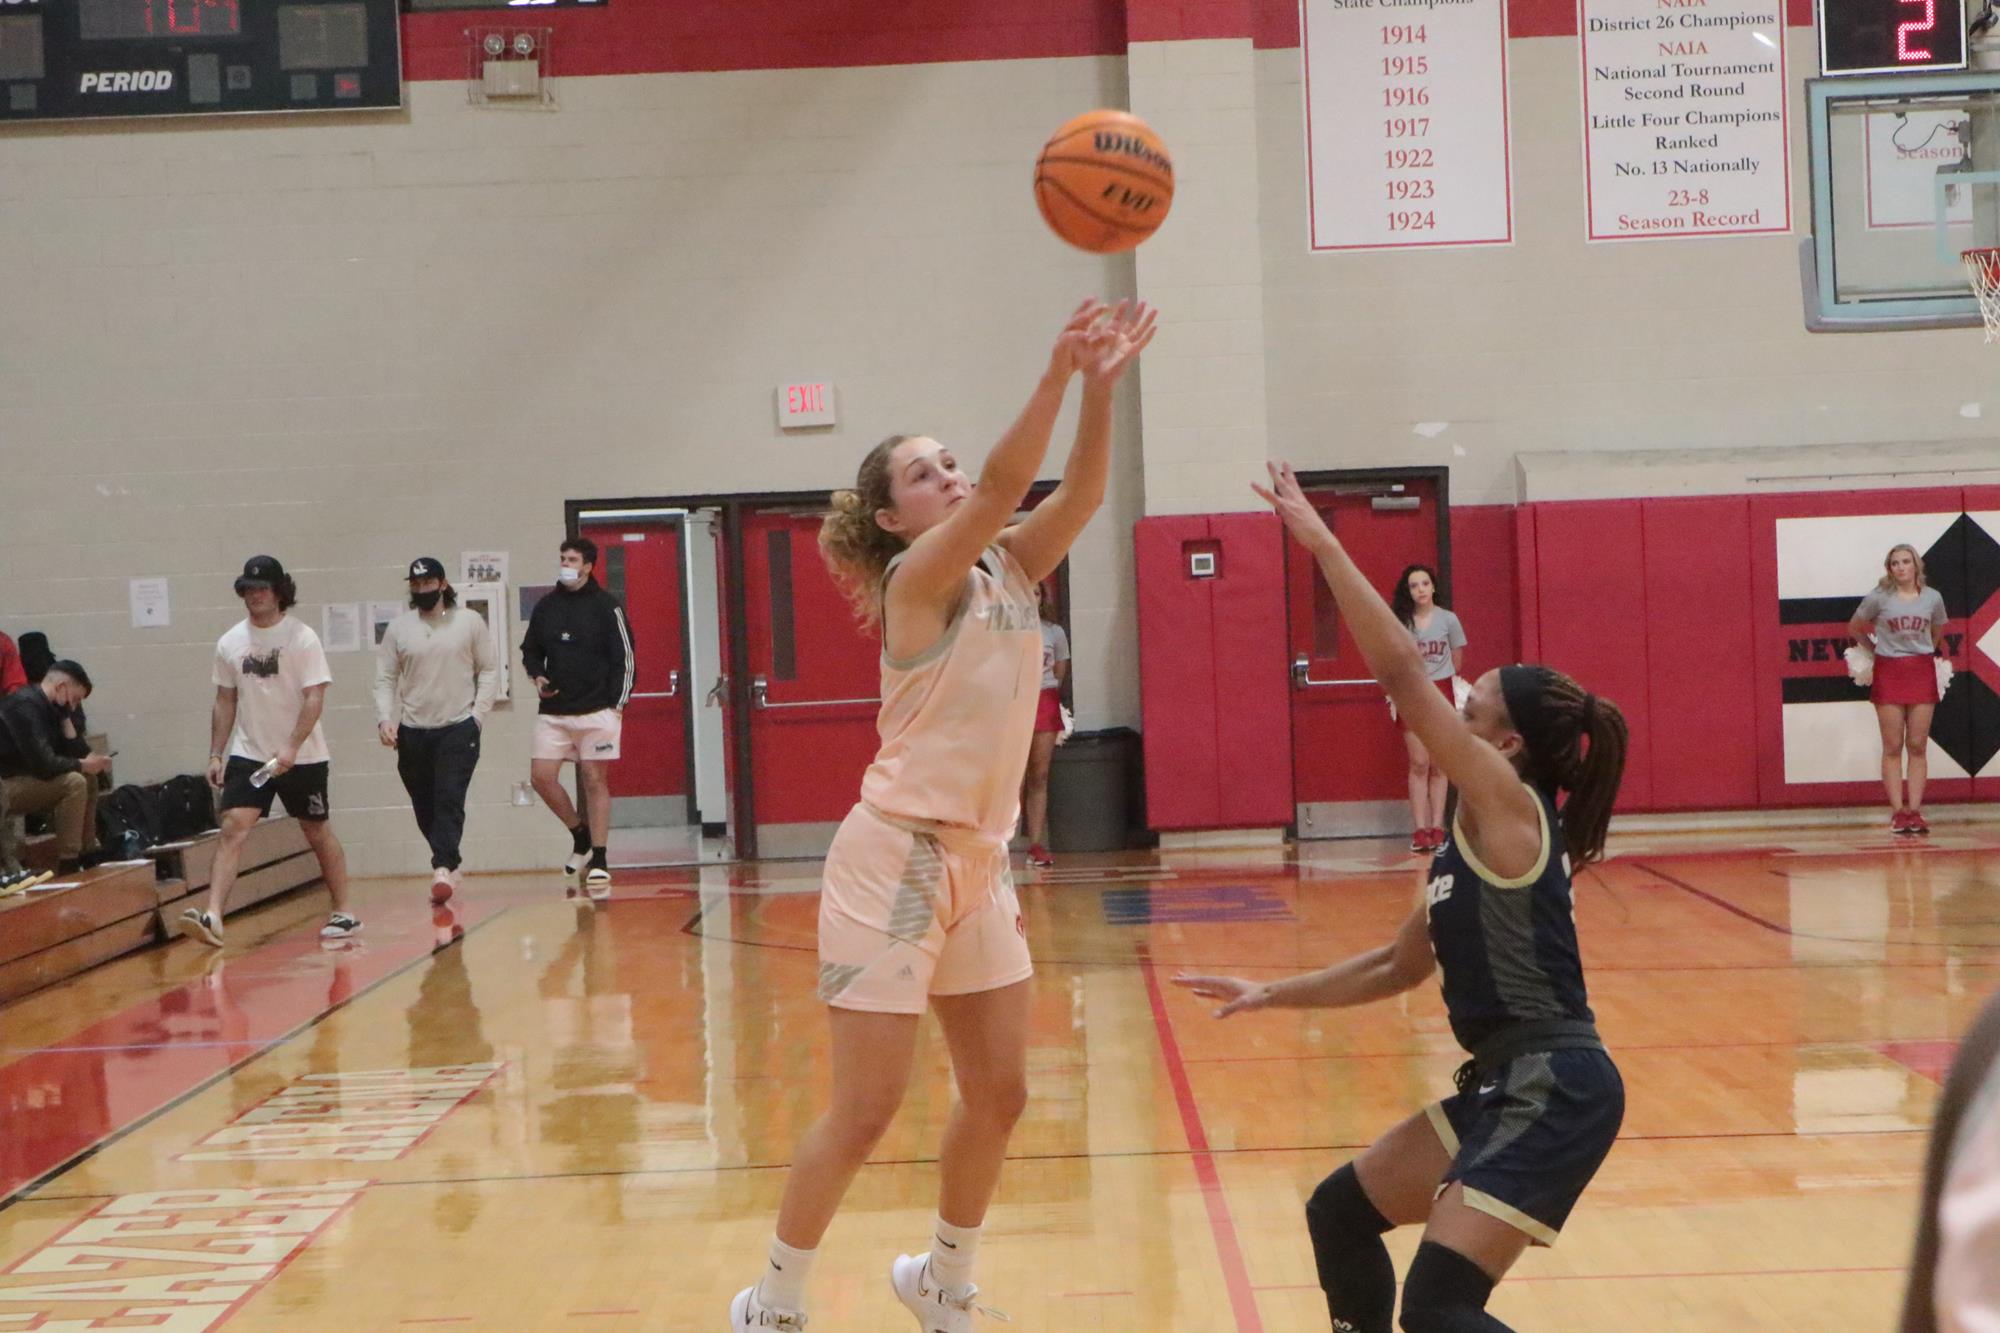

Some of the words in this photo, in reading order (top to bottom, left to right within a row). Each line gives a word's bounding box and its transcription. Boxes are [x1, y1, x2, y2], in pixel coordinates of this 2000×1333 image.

[1589, 17, 1651, 33] District
[1656, 15, 1674, 29] 26
[1680, 12, 1775, 31] Champions
[1898, 0, 1934, 61] 2
[1381, 24, 1427, 45] 1914
[1658, 41, 1709, 56] NAIA
[1382, 56, 1428, 76] 1915
[1594, 65, 1666, 81] National
[1672, 61, 1775, 77] Tournament
[80, 70, 173, 93] PERIOD
[1624, 85, 1684, 101] Second
[1690, 82, 1745, 97] Round
[1382, 87, 1430, 107] 1916
[1384, 118, 1430, 138] 1917
[1592, 113, 1636, 129] Little
[1642, 113, 1680, 127] Four
[1685, 108, 1781, 128] Champions
[1655, 134, 1718, 150] Ranked
[1896, 144, 1963, 160] Season
[1385, 149, 1434, 169] 1922
[1615, 162, 1646, 177] No.
[1652, 161, 1668, 176] 13
[1673, 157, 1760, 175] Nationally
[1386, 180, 1435, 200] 1923
[1668, 189, 1710, 206] 23-8
[1387, 210, 1436, 231] 1924
[1618, 214, 1685, 230] Season
[1692, 209, 1760, 226] Record
[788, 383, 825, 414] EXIT
